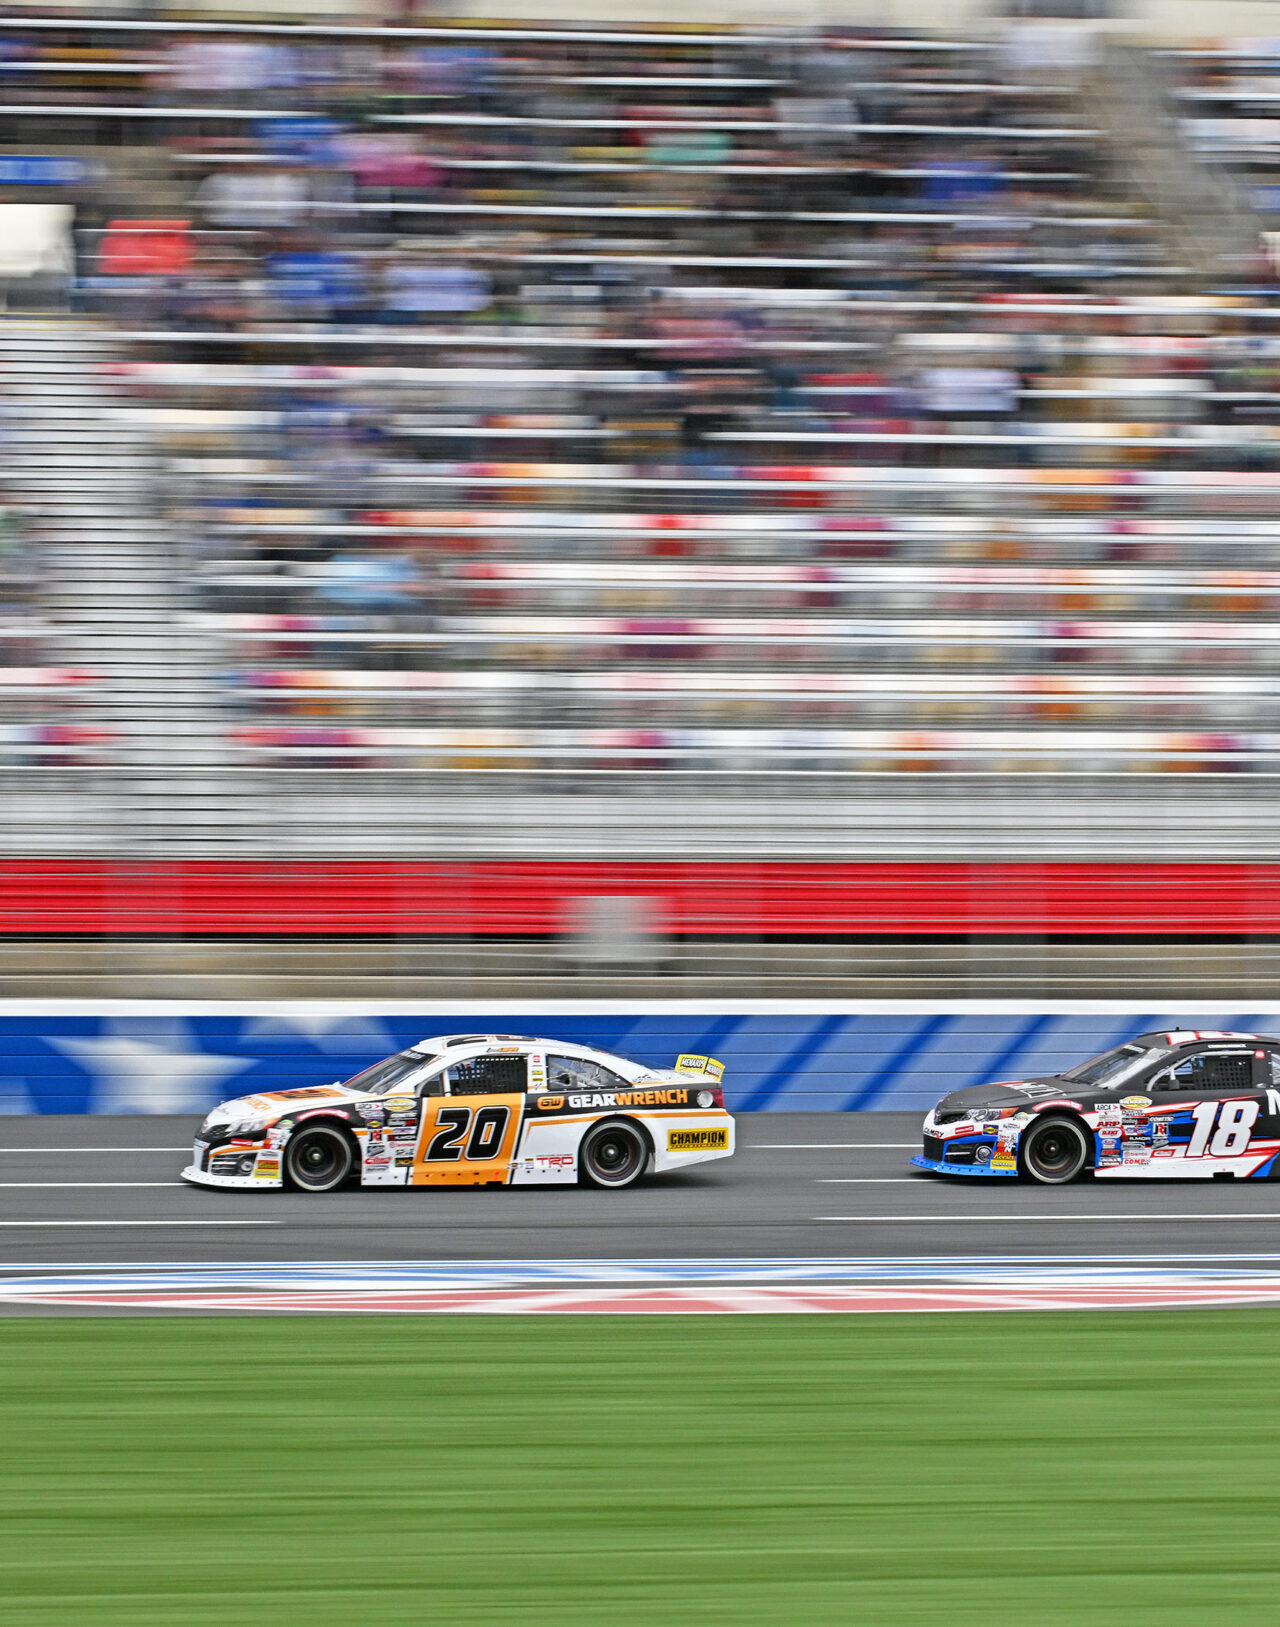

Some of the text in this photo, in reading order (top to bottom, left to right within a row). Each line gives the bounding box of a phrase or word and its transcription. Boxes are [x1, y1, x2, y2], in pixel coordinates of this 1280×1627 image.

[568, 1089, 688, 1108] GEARWRENCH
[423, 1105, 512, 1162] 20
[671, 1131, 725, 1144] CHAMPION
[1184, 1100, 1260, 1158] 18
[536, 1156, 574, 1168] TRD
